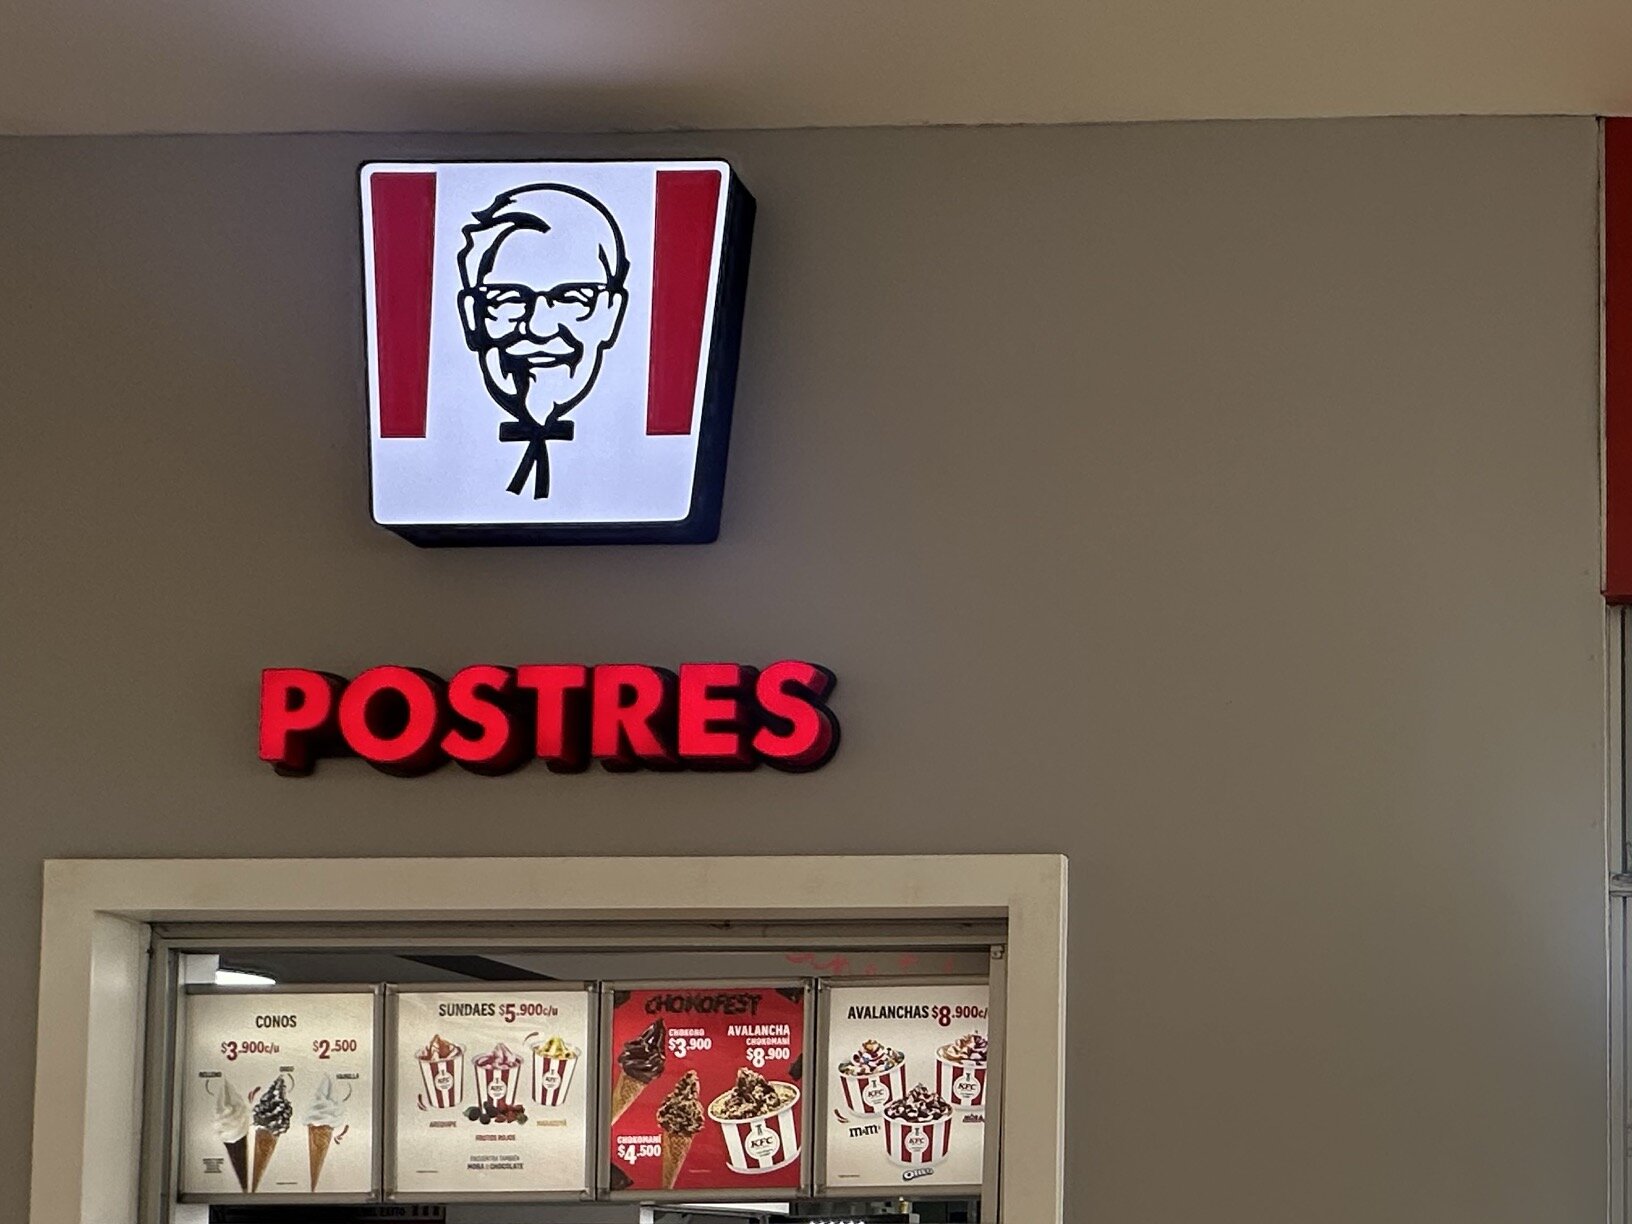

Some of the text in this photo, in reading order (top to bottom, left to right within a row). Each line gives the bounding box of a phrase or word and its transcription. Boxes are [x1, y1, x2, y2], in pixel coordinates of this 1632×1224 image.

[258, 660, 836, 770] POSTRES
[438, 1003, 496, 1017] SUNDAES
[847, 1005, 988, 1026] AVALANCHAS $8.900c/
[255, 1015, 297, 1029] CONOS
[727, 1025, 791, 1036] AVALANCHA
[312, 1039, 357, 1060] $2.500
[668, 1037, 712, 1058] $3.900
[745, 1047, 790, 1067] $8.900
[750, 1136, 774, 1148] KFC
[617, 1145, 662, 1165] $4.500
